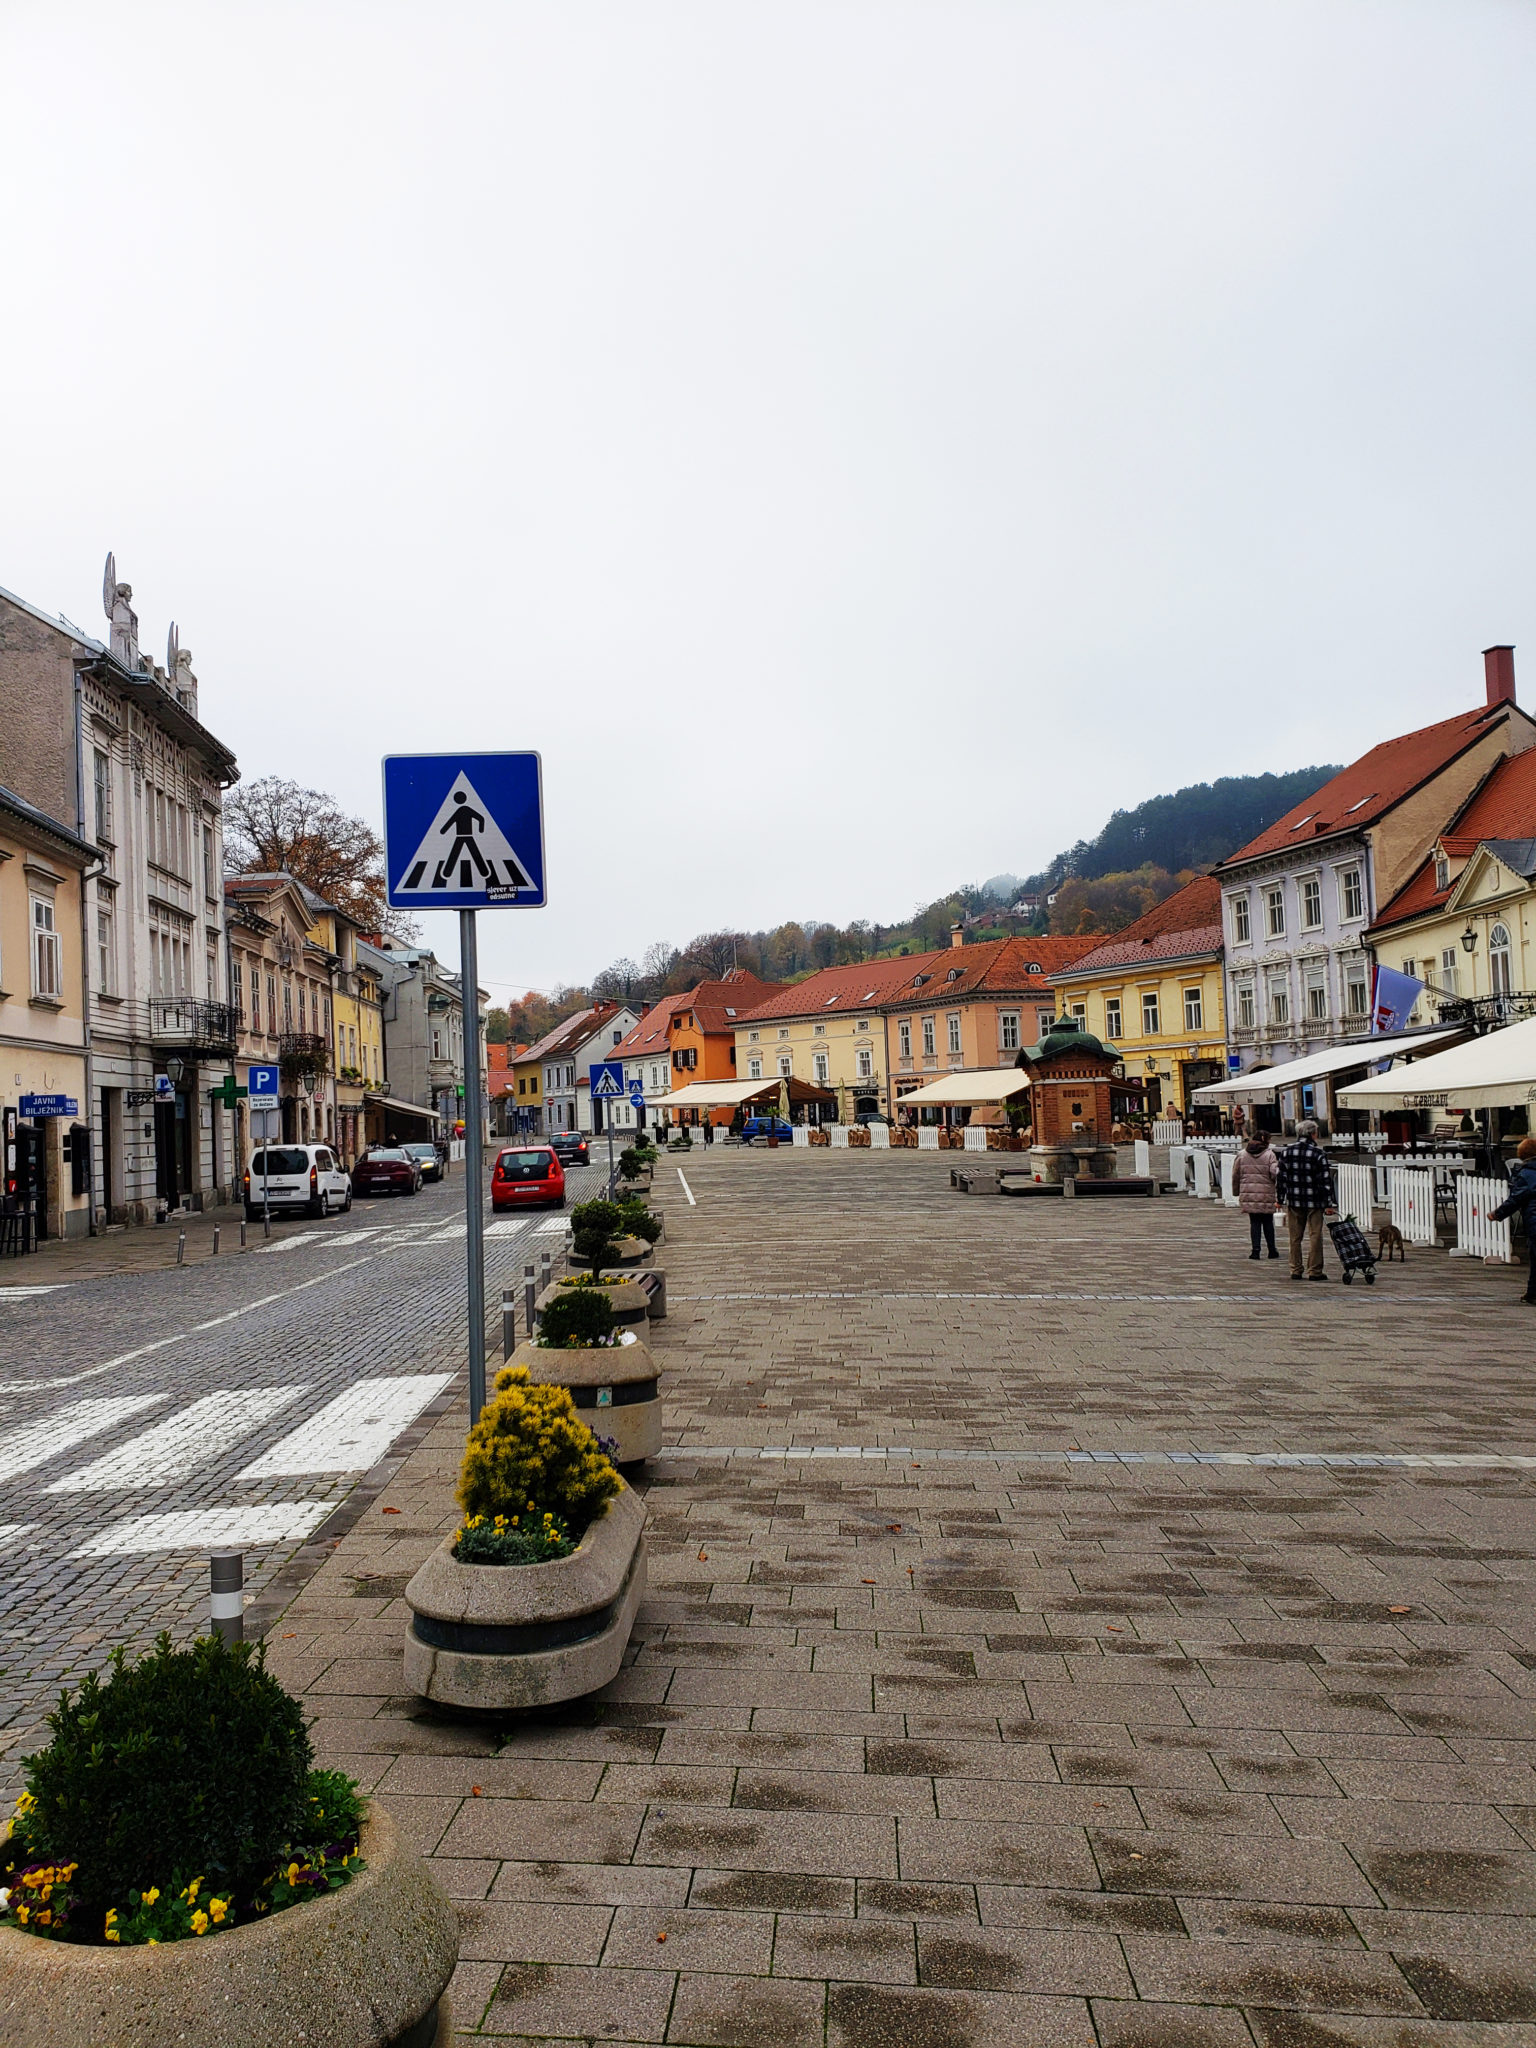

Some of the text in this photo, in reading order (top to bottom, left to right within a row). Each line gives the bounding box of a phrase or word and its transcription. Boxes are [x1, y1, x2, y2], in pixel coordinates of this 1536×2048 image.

[256, 1071, 270, 1090] P
[33, 1097, 56, 1105] JAVNI
[25, 1106, 64, 1115] BILJEŽNIK
